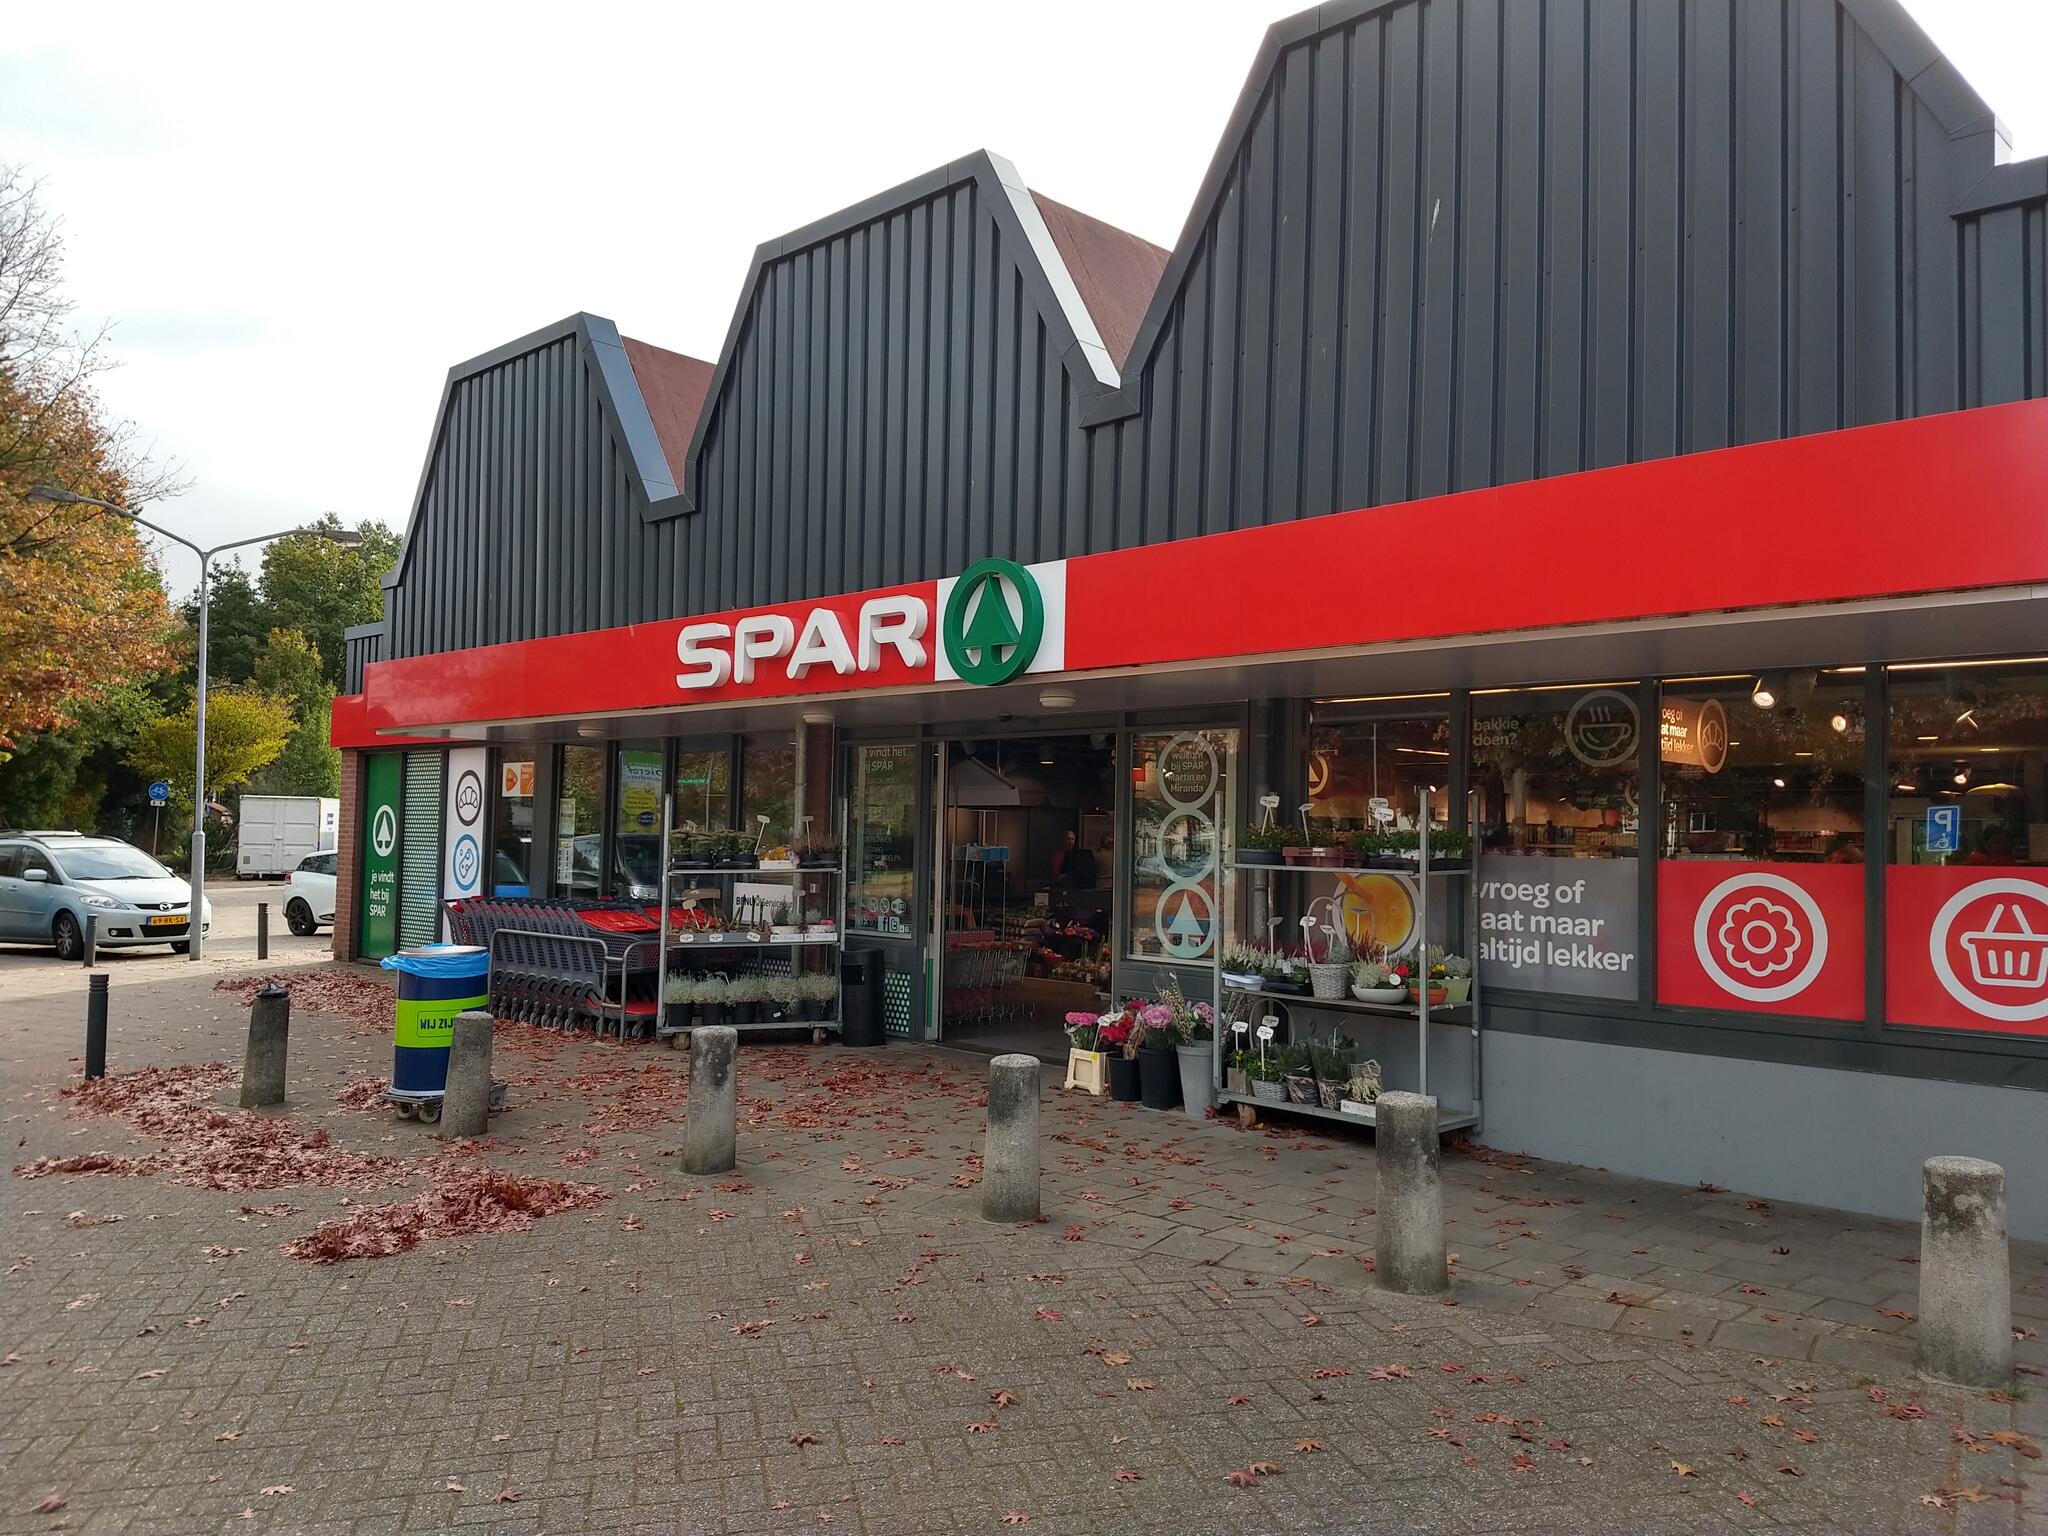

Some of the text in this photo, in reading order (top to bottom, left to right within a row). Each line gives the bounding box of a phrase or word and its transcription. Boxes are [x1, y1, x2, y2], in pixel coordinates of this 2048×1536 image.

[676, 594, 928, 689] SPAR
[1473, 717, 1520, 731] bakkie
[1662, 708, 1676, 724] oeg
[1661, 722, 1688, 738] at maar
[1472, 732, 1518, 746] doen?
[1661, 737, 1694, 754] tijd lekker
[869, 746, 892, 757] vindt
[892, 746, 906, 757] het
[871, 760, 894, 771] SPAR
[1171, 761, 1204, 772] bij SPAR
[1170, 783, 1204, 792] Miranda
[370, 869, 395, 885] je vindt
[370, 887, 390, 904] het bij
[1555, 880, 1586, 903] of
[369, 904, 386, 917] SPAR
[1481, 910, 1605, 937] aat maar
[1547, 940, 1635, 972] lekker
[420, 1018, 454, 1030] WIJ ZIJ
